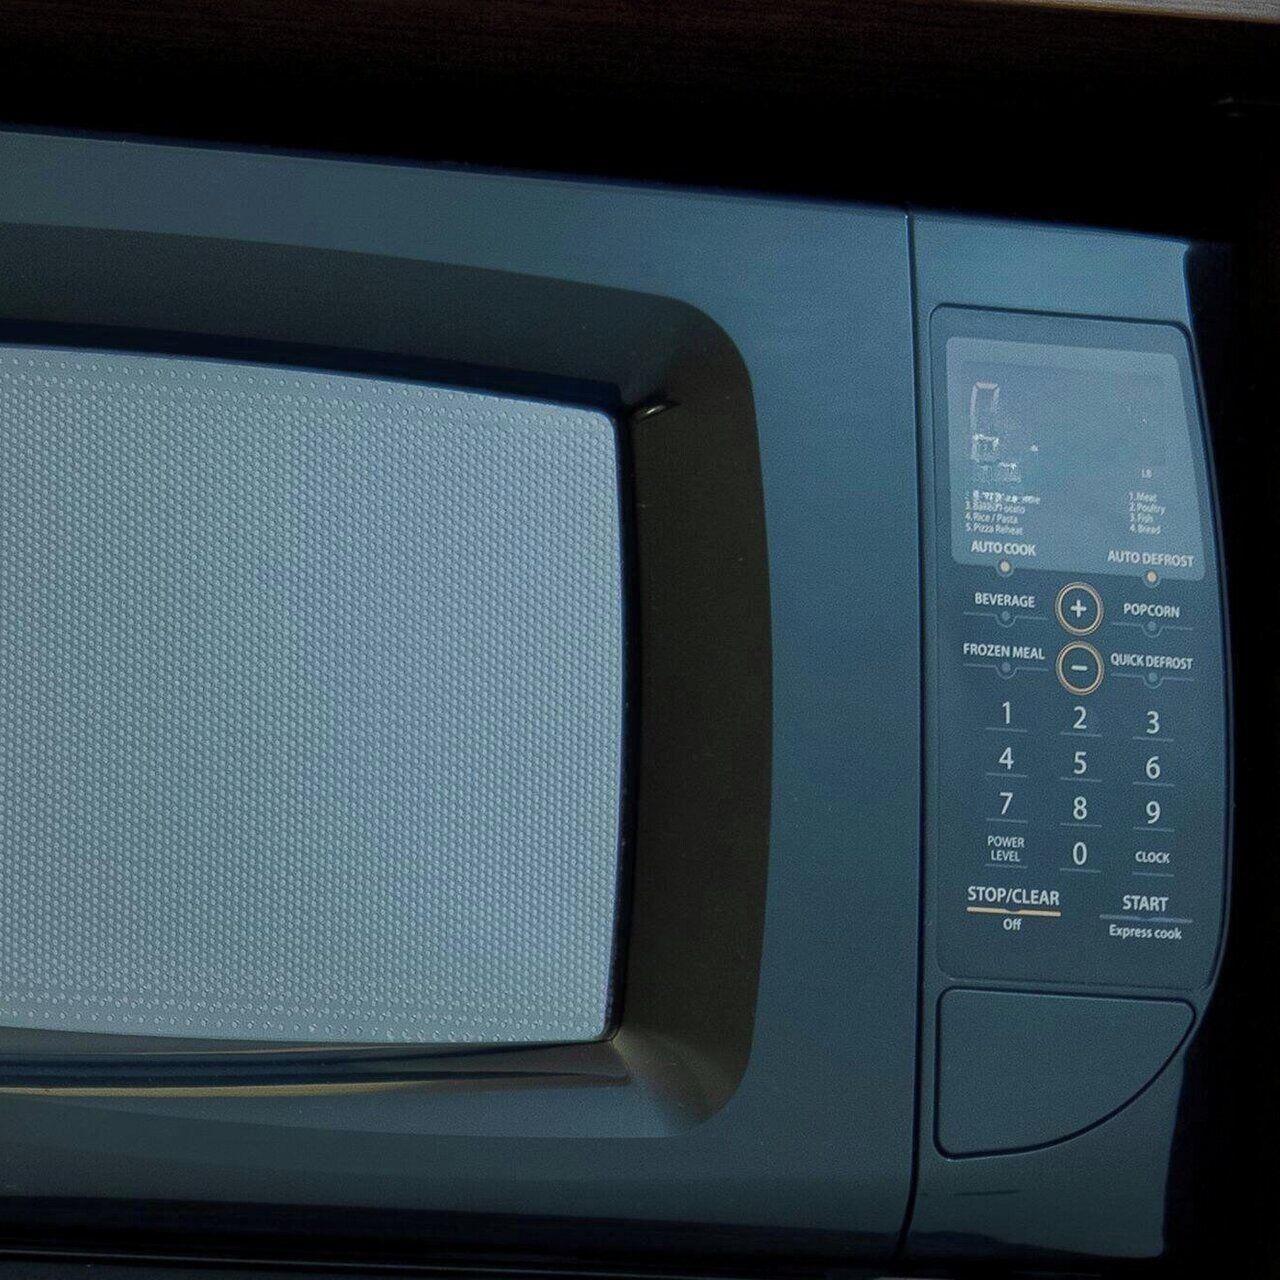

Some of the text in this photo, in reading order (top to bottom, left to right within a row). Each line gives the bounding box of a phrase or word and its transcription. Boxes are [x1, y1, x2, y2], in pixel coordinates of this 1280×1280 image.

[971, 540, 1036, 556] AUTO COOK
[1108, 550, 1194, 567] AUTO DEFROST
[975, 592, 1035, 608] BEVERAGE
[1124, 603, 1180, 618] POPCORN
[963, 643, 1045, 660] FROZEN MEAL
[1111, 653, 1193, 669] QUICK DEFROST
[1002, 702, 1011, 724] 1
[1073, 707, 1087, 729] 2
[1147, 711, 1160, 733] 3
[999, 747, 1014, 769] 4
[1074, 752, 1087, 774] 5
[1146, 756, 1160, 778] 6
[1000, 792, 1013, 814] 7
[1073, 797, 1087, 820] 8
[1146, 801, 1160, 823] 9
[988, 836, 1024, 848] POWER
[991, 850, 1020, 862] LEVEL
[1072, 842, 1087, 865] 0
[1135, 851, 1170, 863] CLOCK
[968, 887, 1059, 906] STOP/CLEAR
[1123, 895, 1168, 911] START
[1003, 918, 1022, 931] Off
[1109, 925, 1182, 940] Express cook
